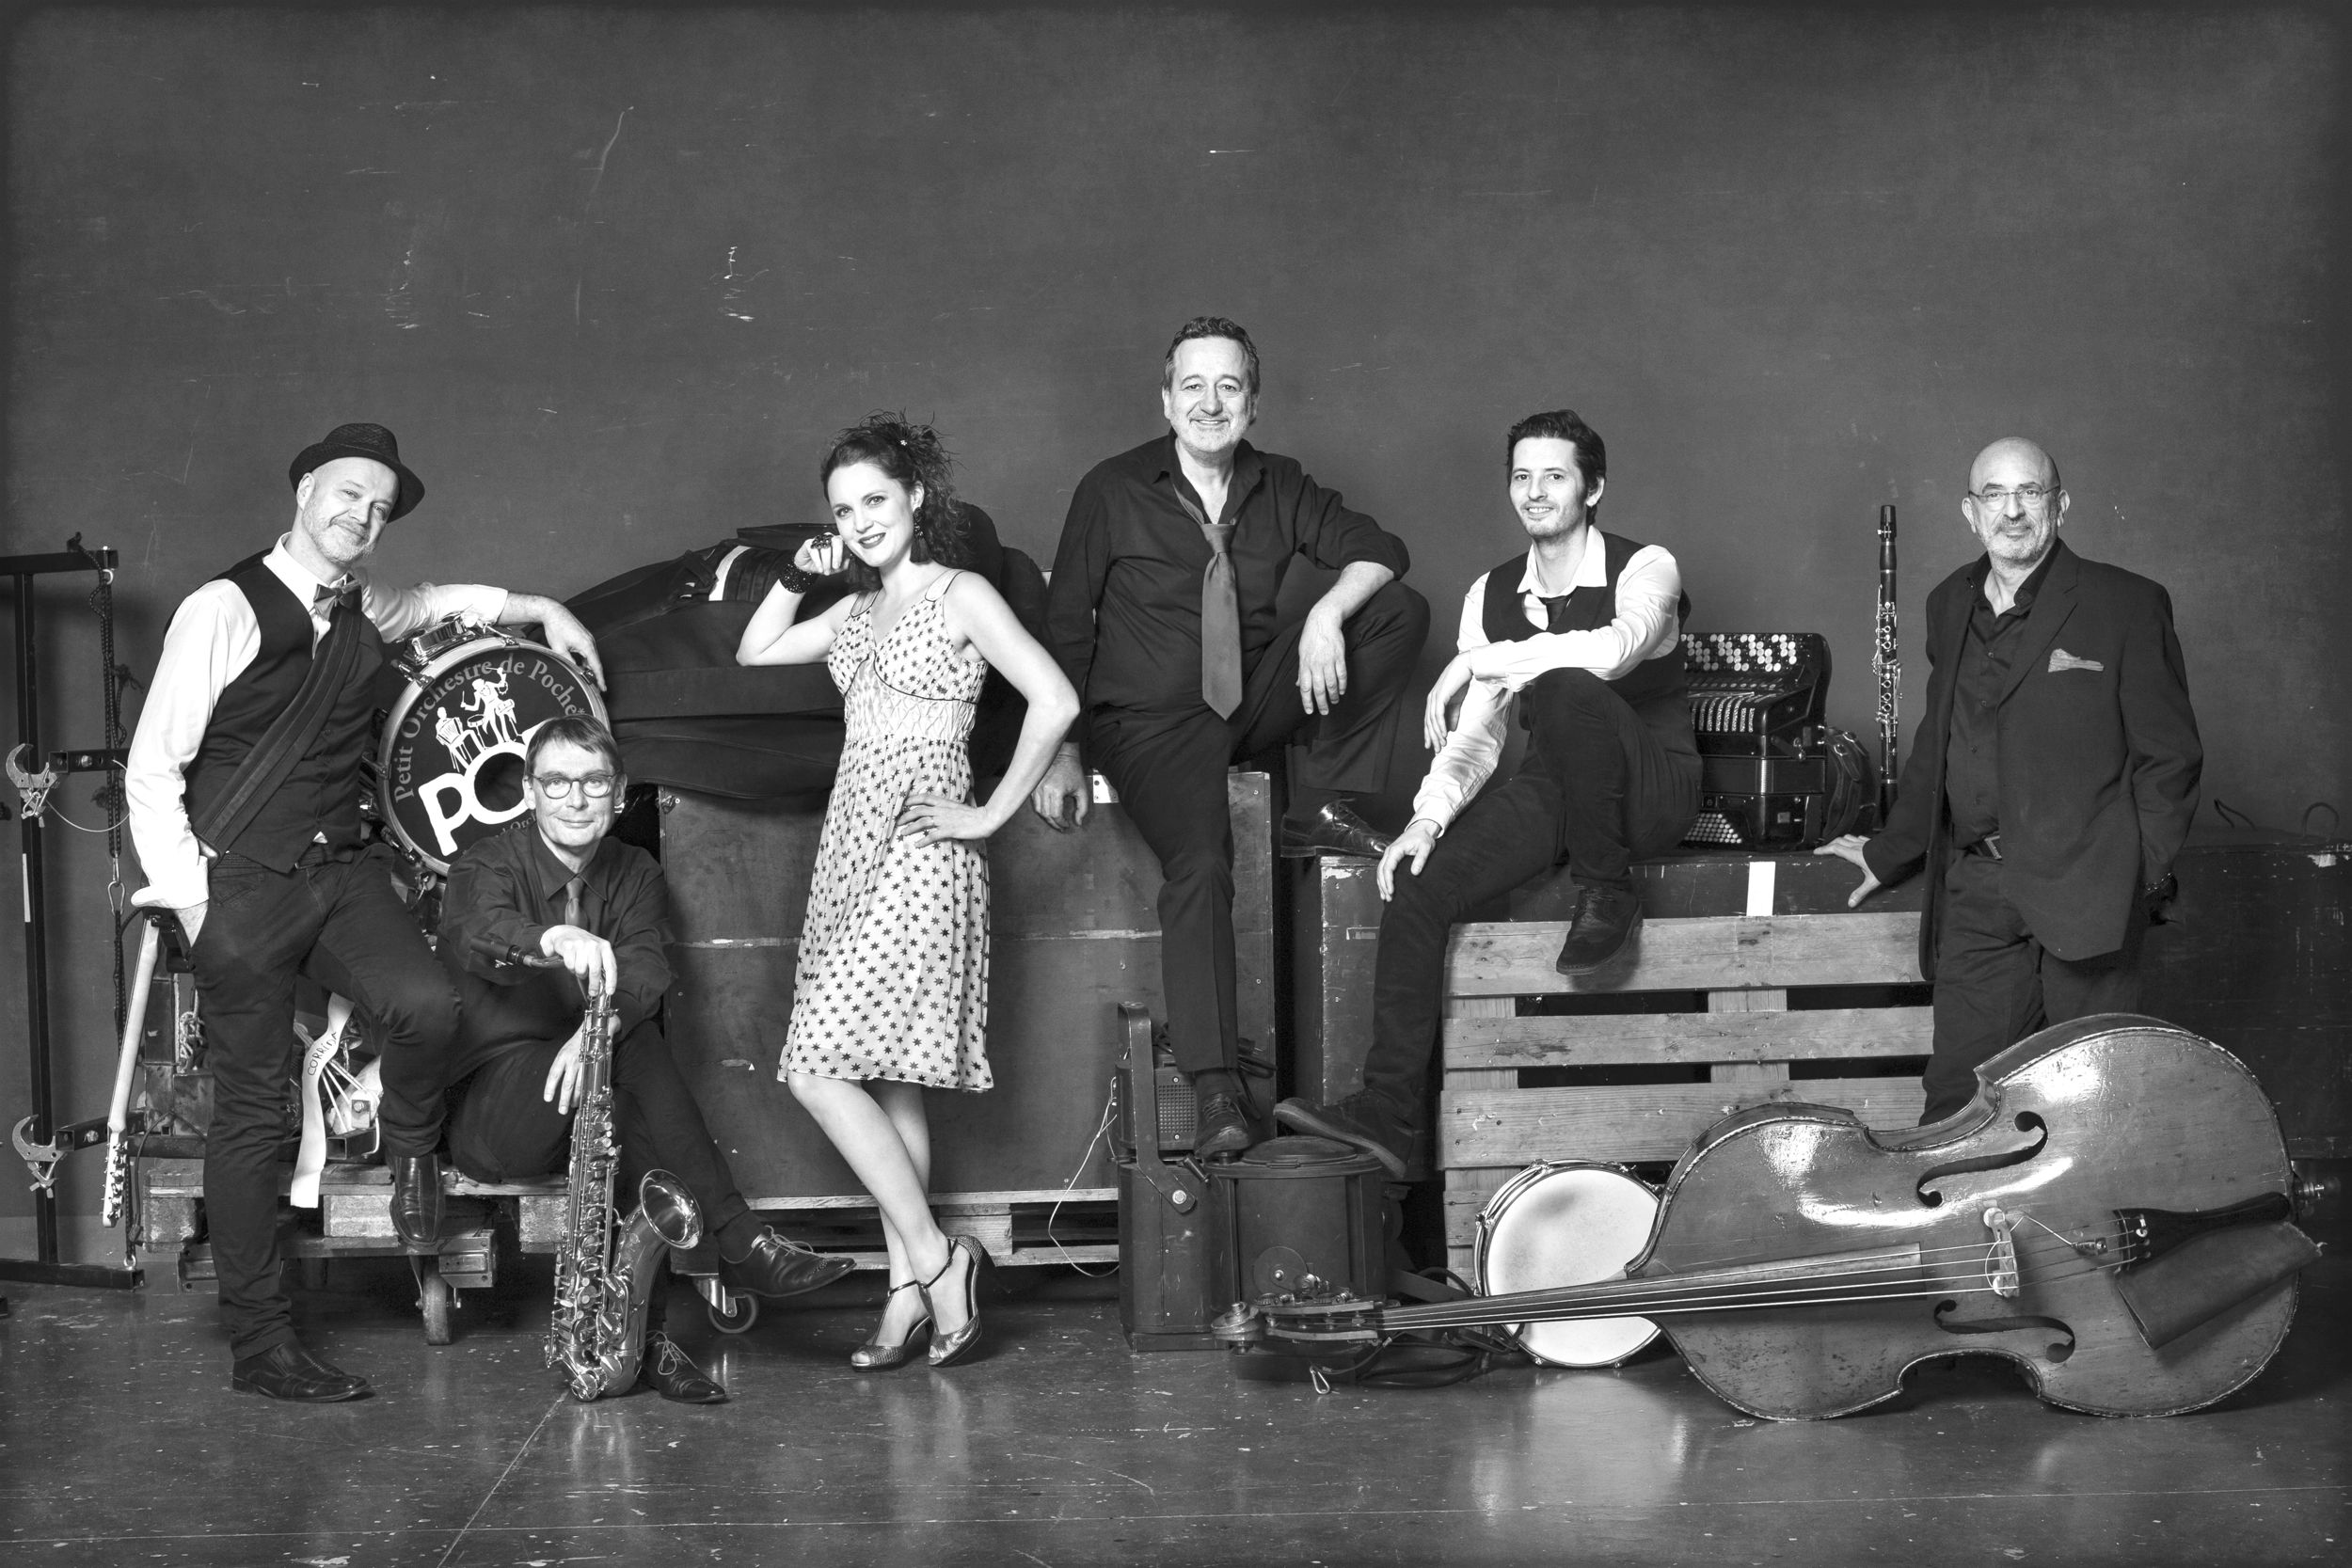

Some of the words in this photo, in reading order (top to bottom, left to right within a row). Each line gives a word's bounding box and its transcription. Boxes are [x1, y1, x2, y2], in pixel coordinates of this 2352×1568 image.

[499, 653, 525, 675] de
[401, 660, 492, 739] Orchestre
[393, 746, 415, 802] Petit
